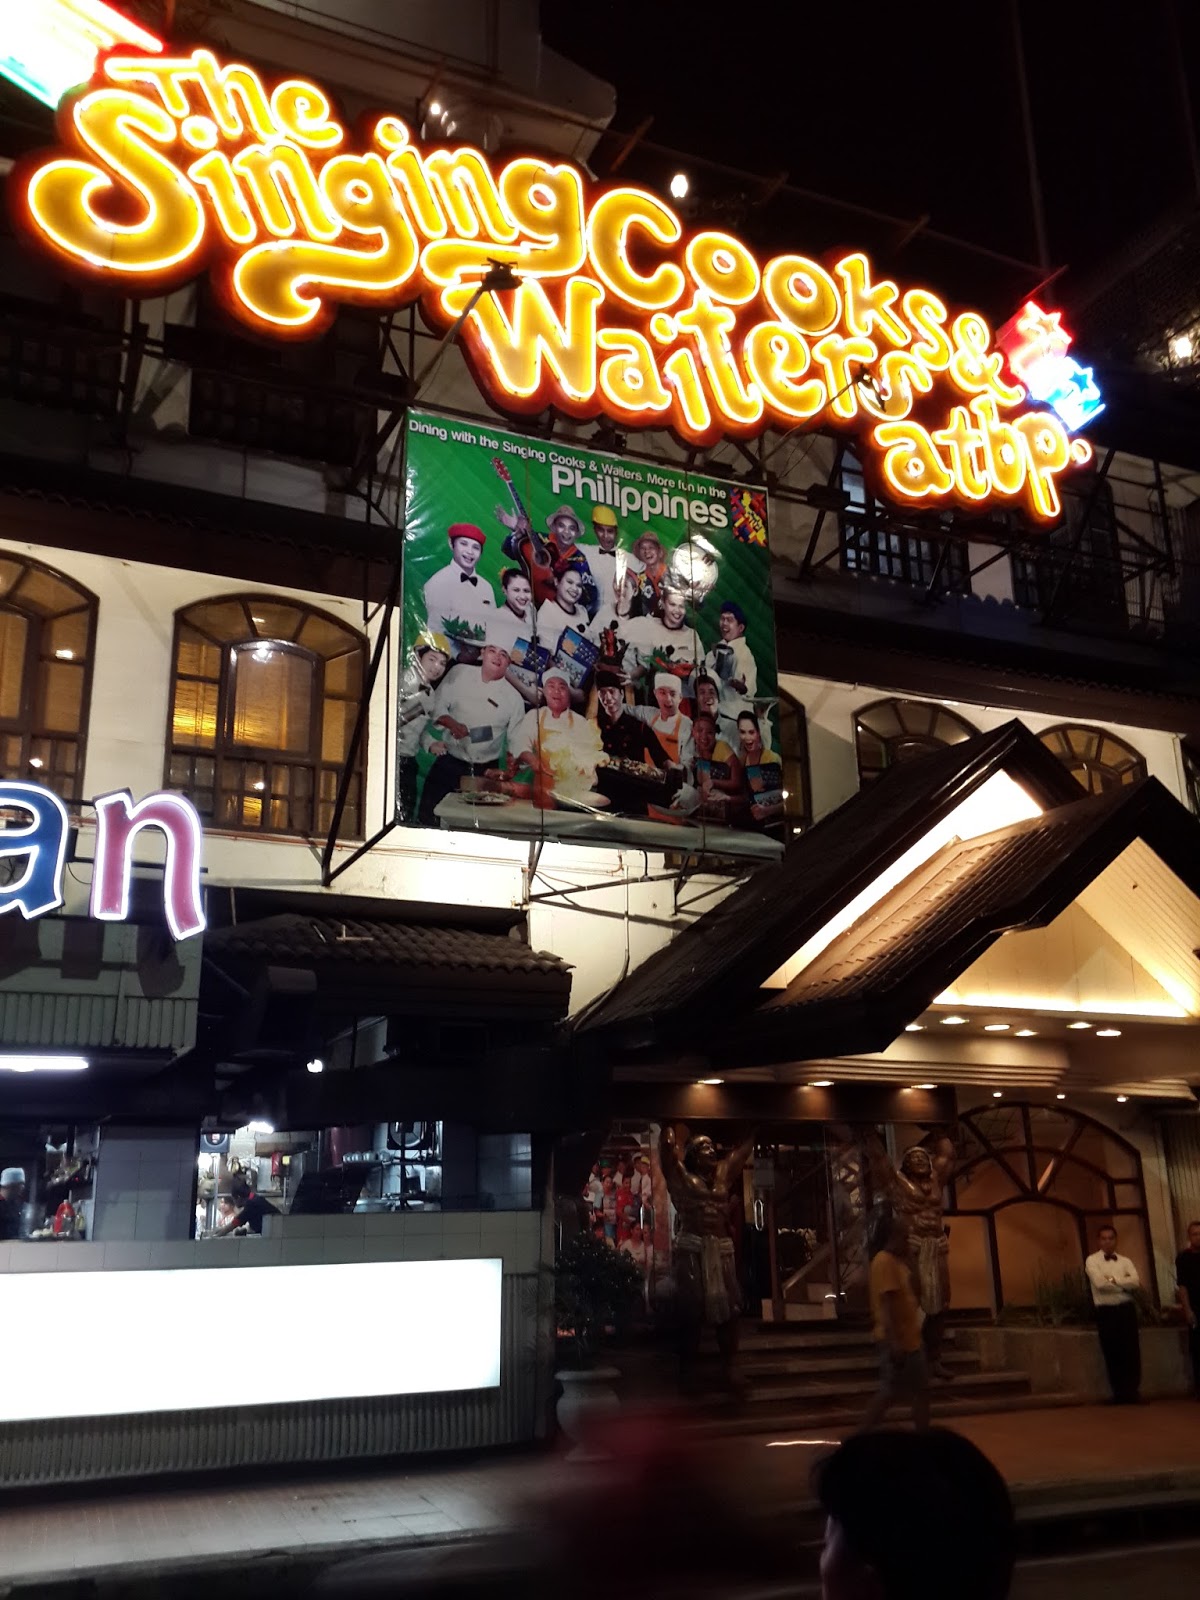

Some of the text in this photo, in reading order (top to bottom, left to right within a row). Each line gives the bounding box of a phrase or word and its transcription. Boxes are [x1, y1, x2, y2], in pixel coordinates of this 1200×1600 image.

[103, 48, 345, 150] The
[27, 88, 1026, 407] Singing Cooks &
[440, 276, 935, 431] Waiters
[408, 419, 727, 500] Dining with the Singing Cooks & Waiters. More fun in the
[551, 463, 729, 529] Philippines
[873, 395, 1093, 518] atbp.
